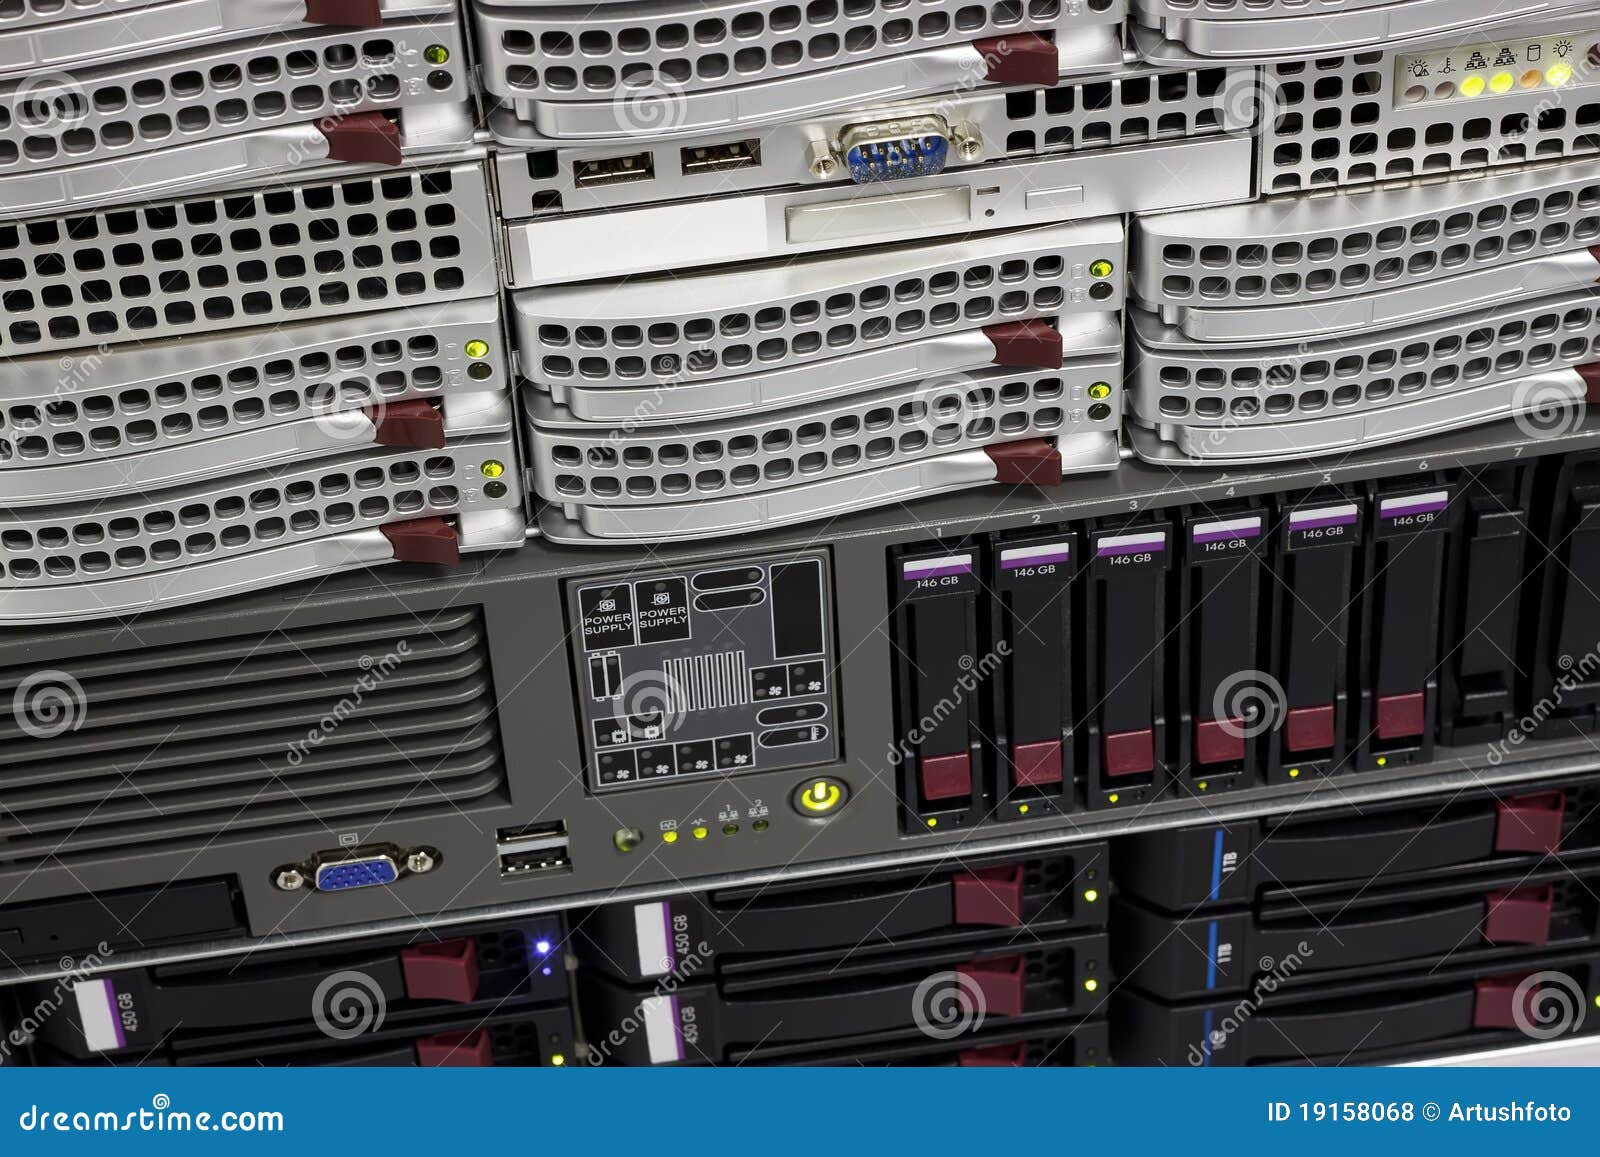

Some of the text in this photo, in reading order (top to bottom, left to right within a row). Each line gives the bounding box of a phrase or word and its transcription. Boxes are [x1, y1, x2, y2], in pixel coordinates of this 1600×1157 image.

[1514, 446, 1523, 457] 7
[1418, 460, 1429, 470] 6
[1322, 473, 1332, 483] 5
[1225, 486, 1235, 497] 4
[1129, 500, 1138, 510] 3
[1032, 514, 1041, 524] 2
[1393, 513, 1434, 527] 146 GB
[936, 527, 942, 537] 1
[1302, 526, 1344, 539] 146 GB
[1205, 539, 1247, 552] 146 GB
[1109, 553, 1152, 565] 146 GB
[1014, 564, 1056, 578] 146 GB
[916, 576, 959, 589] 146 GB
[640, 606, 687, 619] POWER
[584, 613, 631, 626] POWER
[639, 615, 688, 629] SUPPLY
[584, 621, 633, 635] SUPPLY
[674, 914, 690, 954] 450 GB
[118, 992, 138, 1032] 450 GB
[681, 1006, 696, 1022] GB
